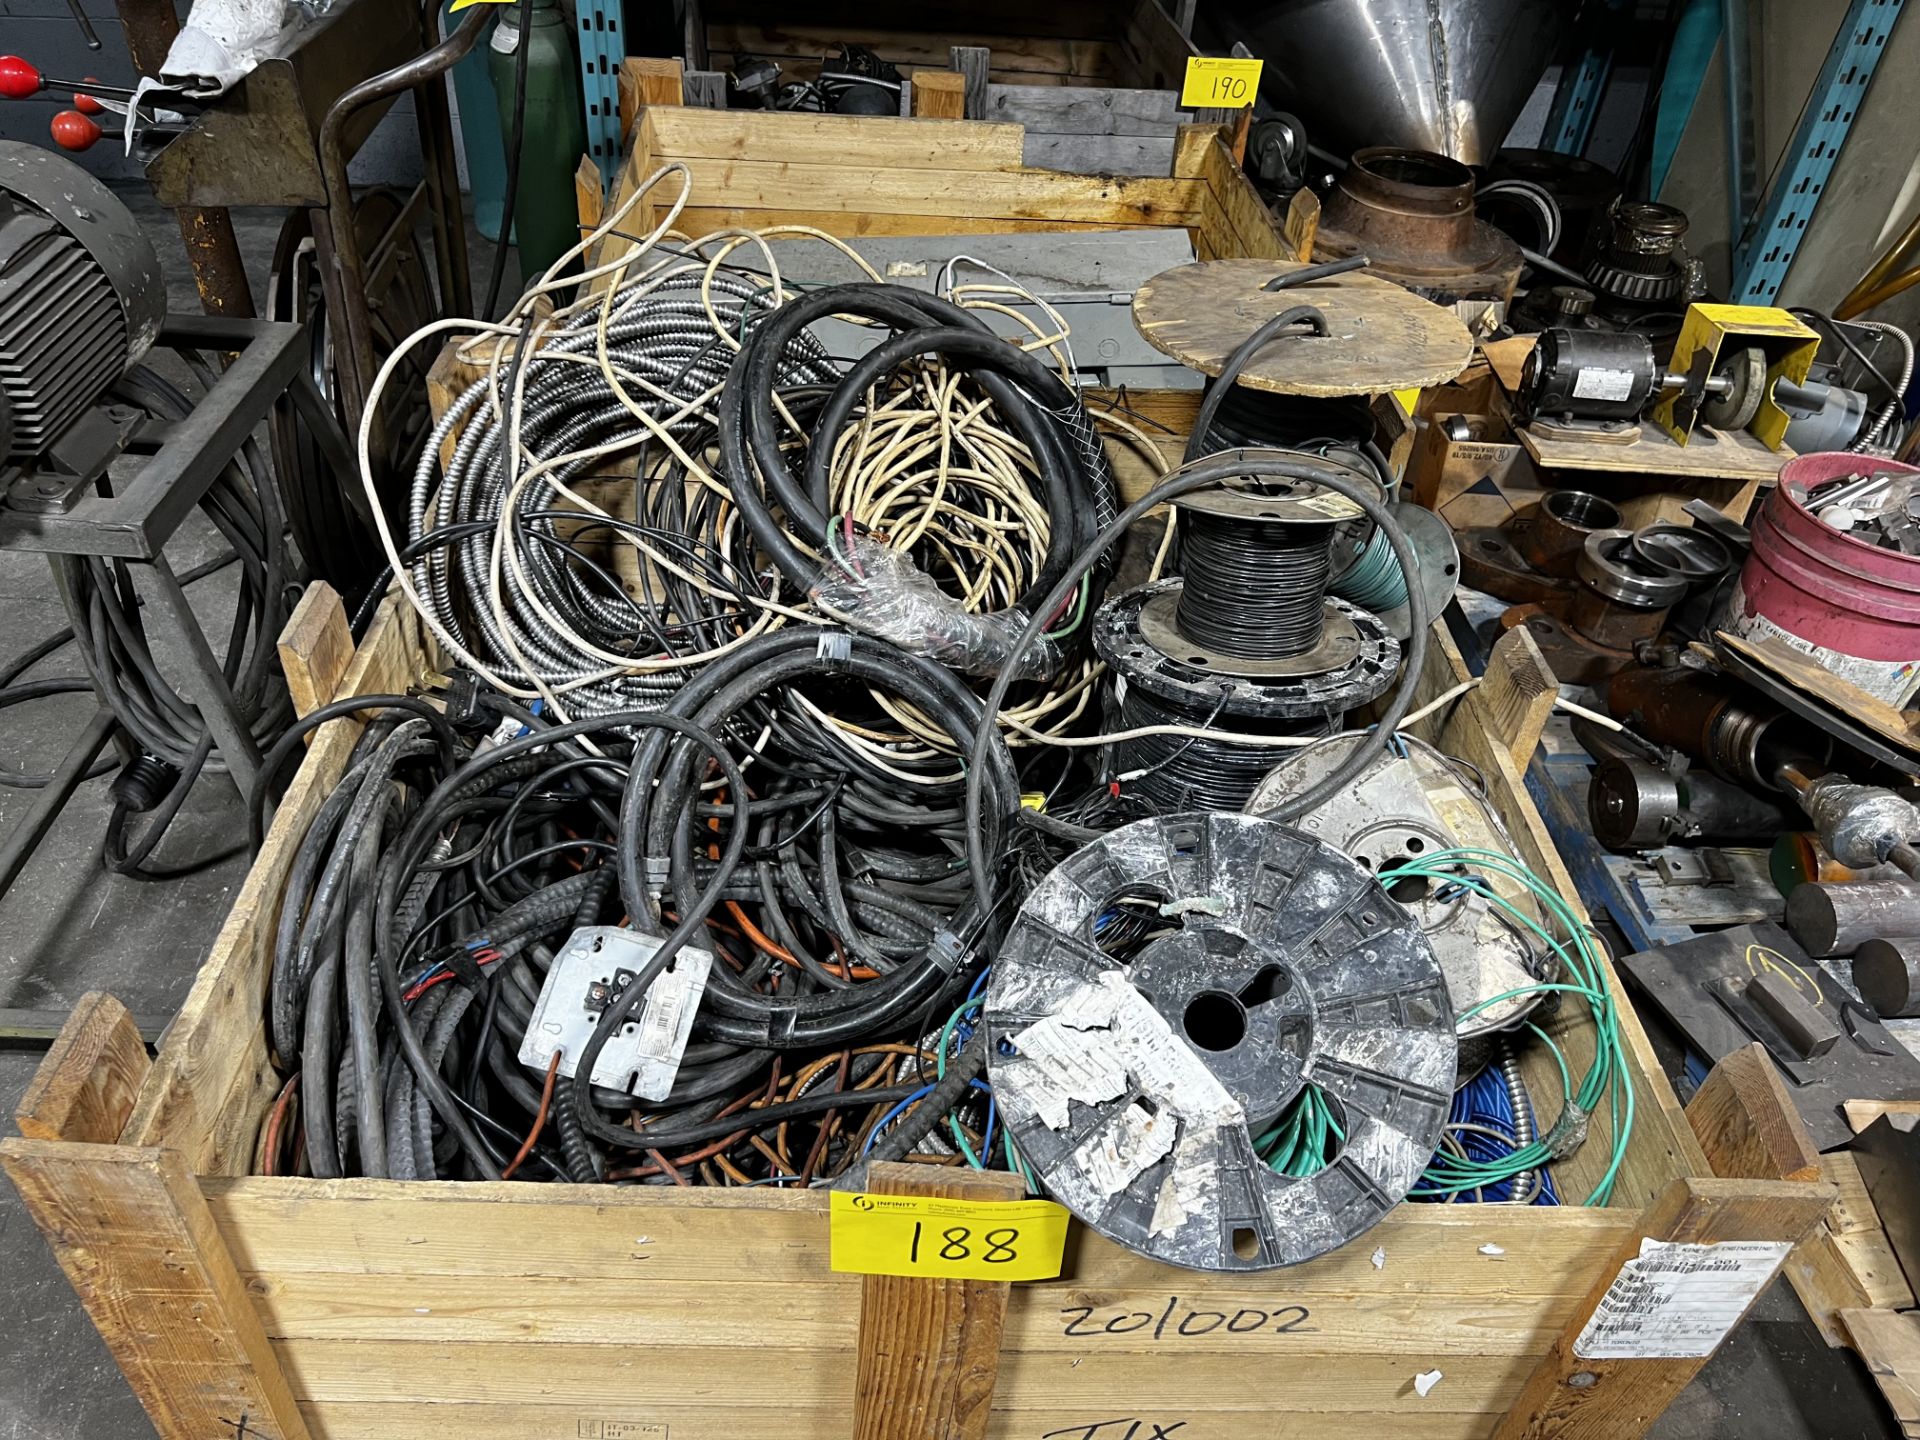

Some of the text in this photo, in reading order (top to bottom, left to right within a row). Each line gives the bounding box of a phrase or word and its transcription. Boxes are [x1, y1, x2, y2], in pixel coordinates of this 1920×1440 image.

[1212, 76, 1247, 100] 190
[876, 1201, 919, 1209] INFINITY
[910, 1221, 1020, 1264] 188
